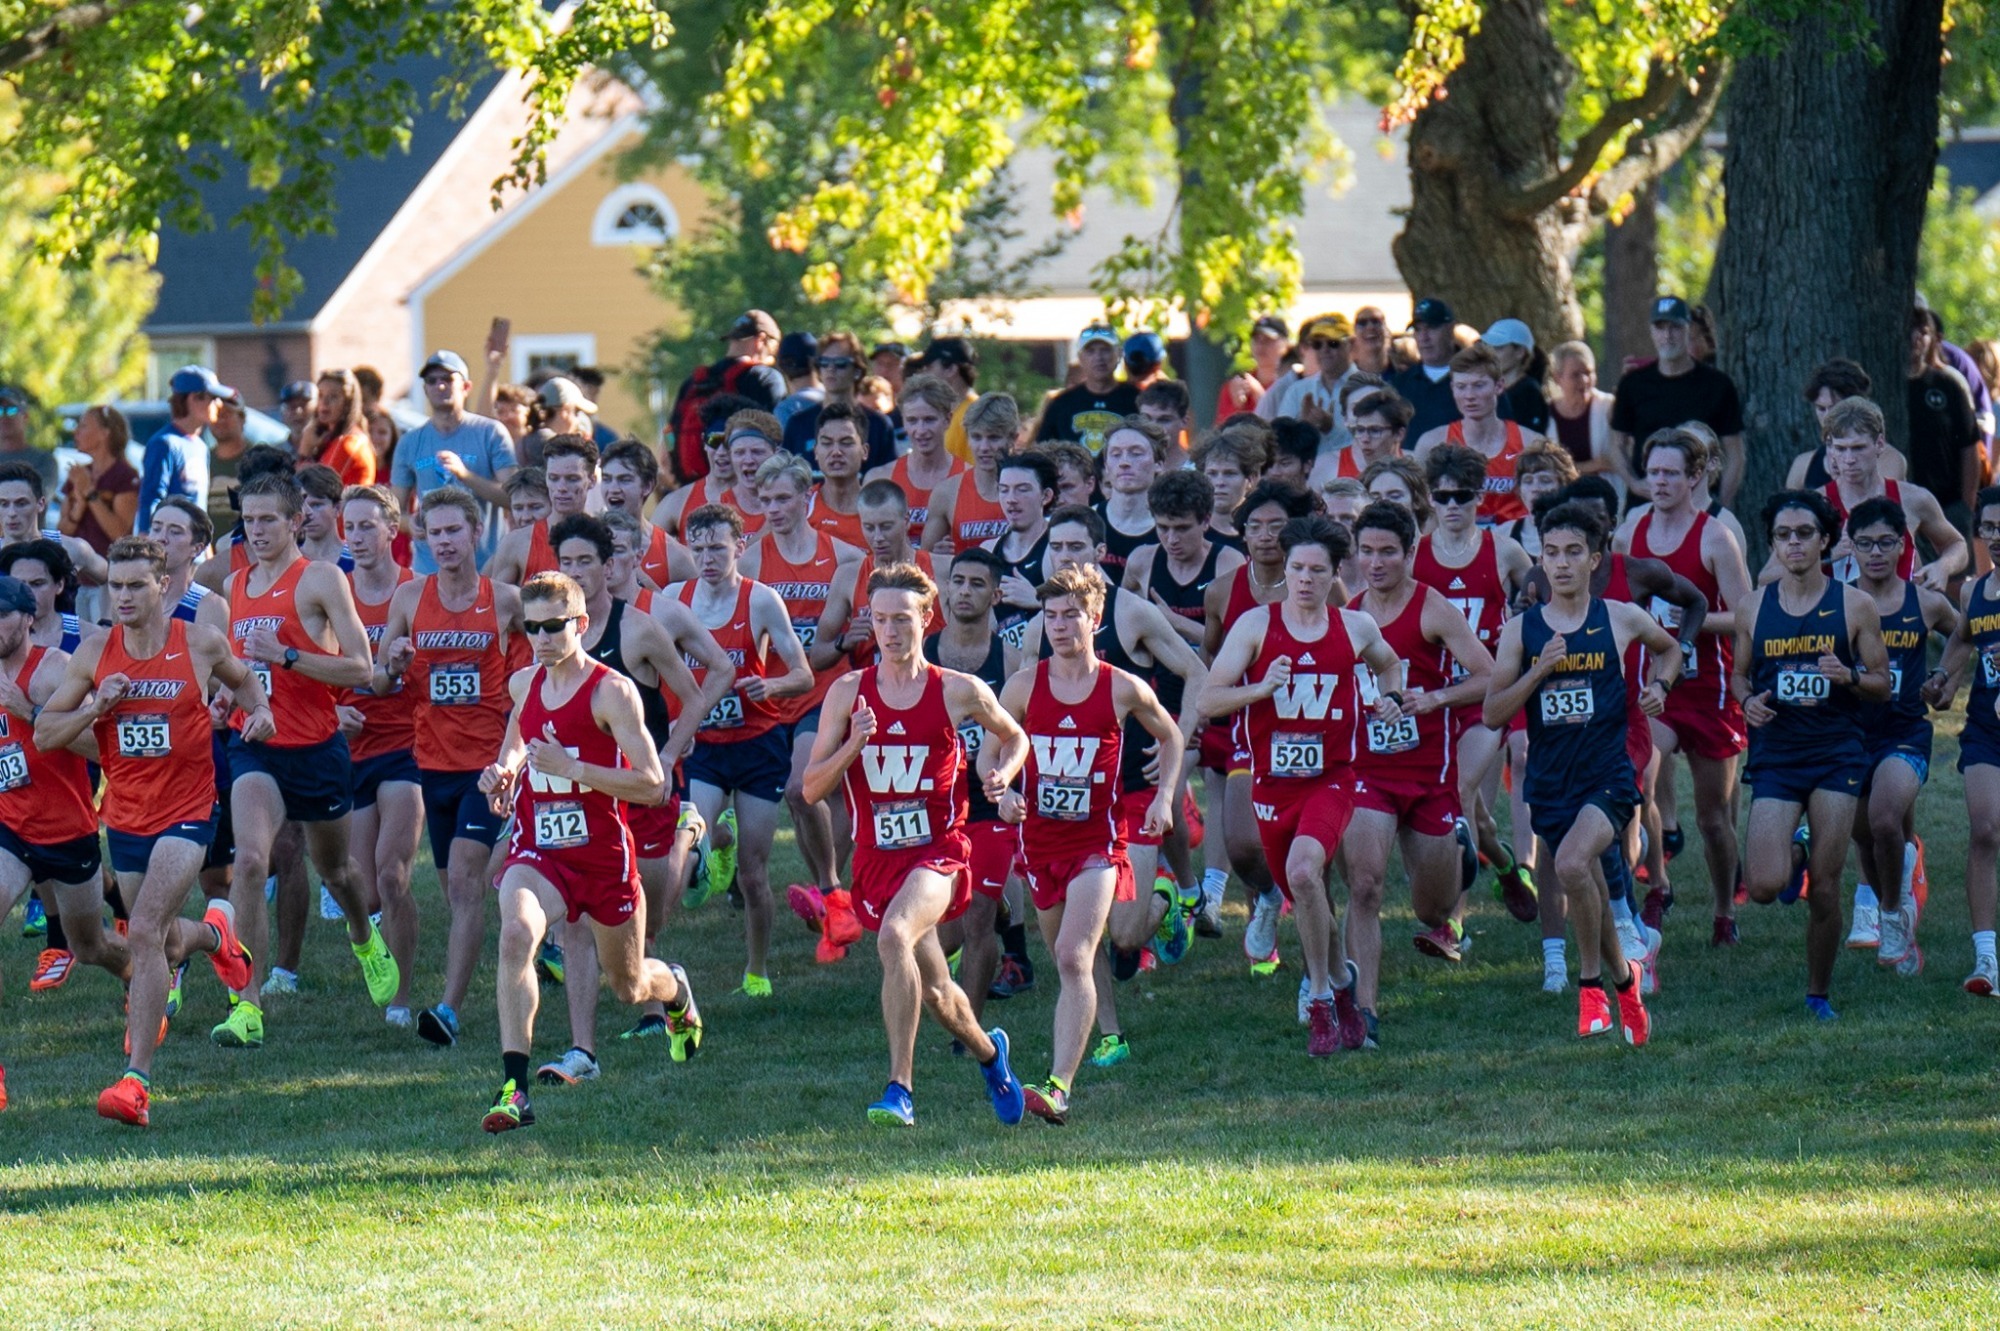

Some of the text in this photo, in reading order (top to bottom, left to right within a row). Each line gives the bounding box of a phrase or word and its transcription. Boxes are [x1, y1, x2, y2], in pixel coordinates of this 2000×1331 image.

[961, 521, 1009, 537] WHEAT
[773, 584, 829, 598] HEATON
[418, 631, 491, 648] WHEATON
[1764, 635, 1835, 657] DOMINICAN
[126, 681, 183, 698] EATON
[435, 674, 476, 696] 553
[1782, 675, 1825, 697] 340
[704, 699, 738, 721] 32
[1545, 691, 1589, 716] 335
[123, 726, 164, 748] 535
[1373, 720, 1413, 746] 525
[1275, 746, 1319, 767] 520
[1042, 787, 1086, 811] 527
[540, 813, 583, 840] 512
[880, 812, 922, 840] 511
